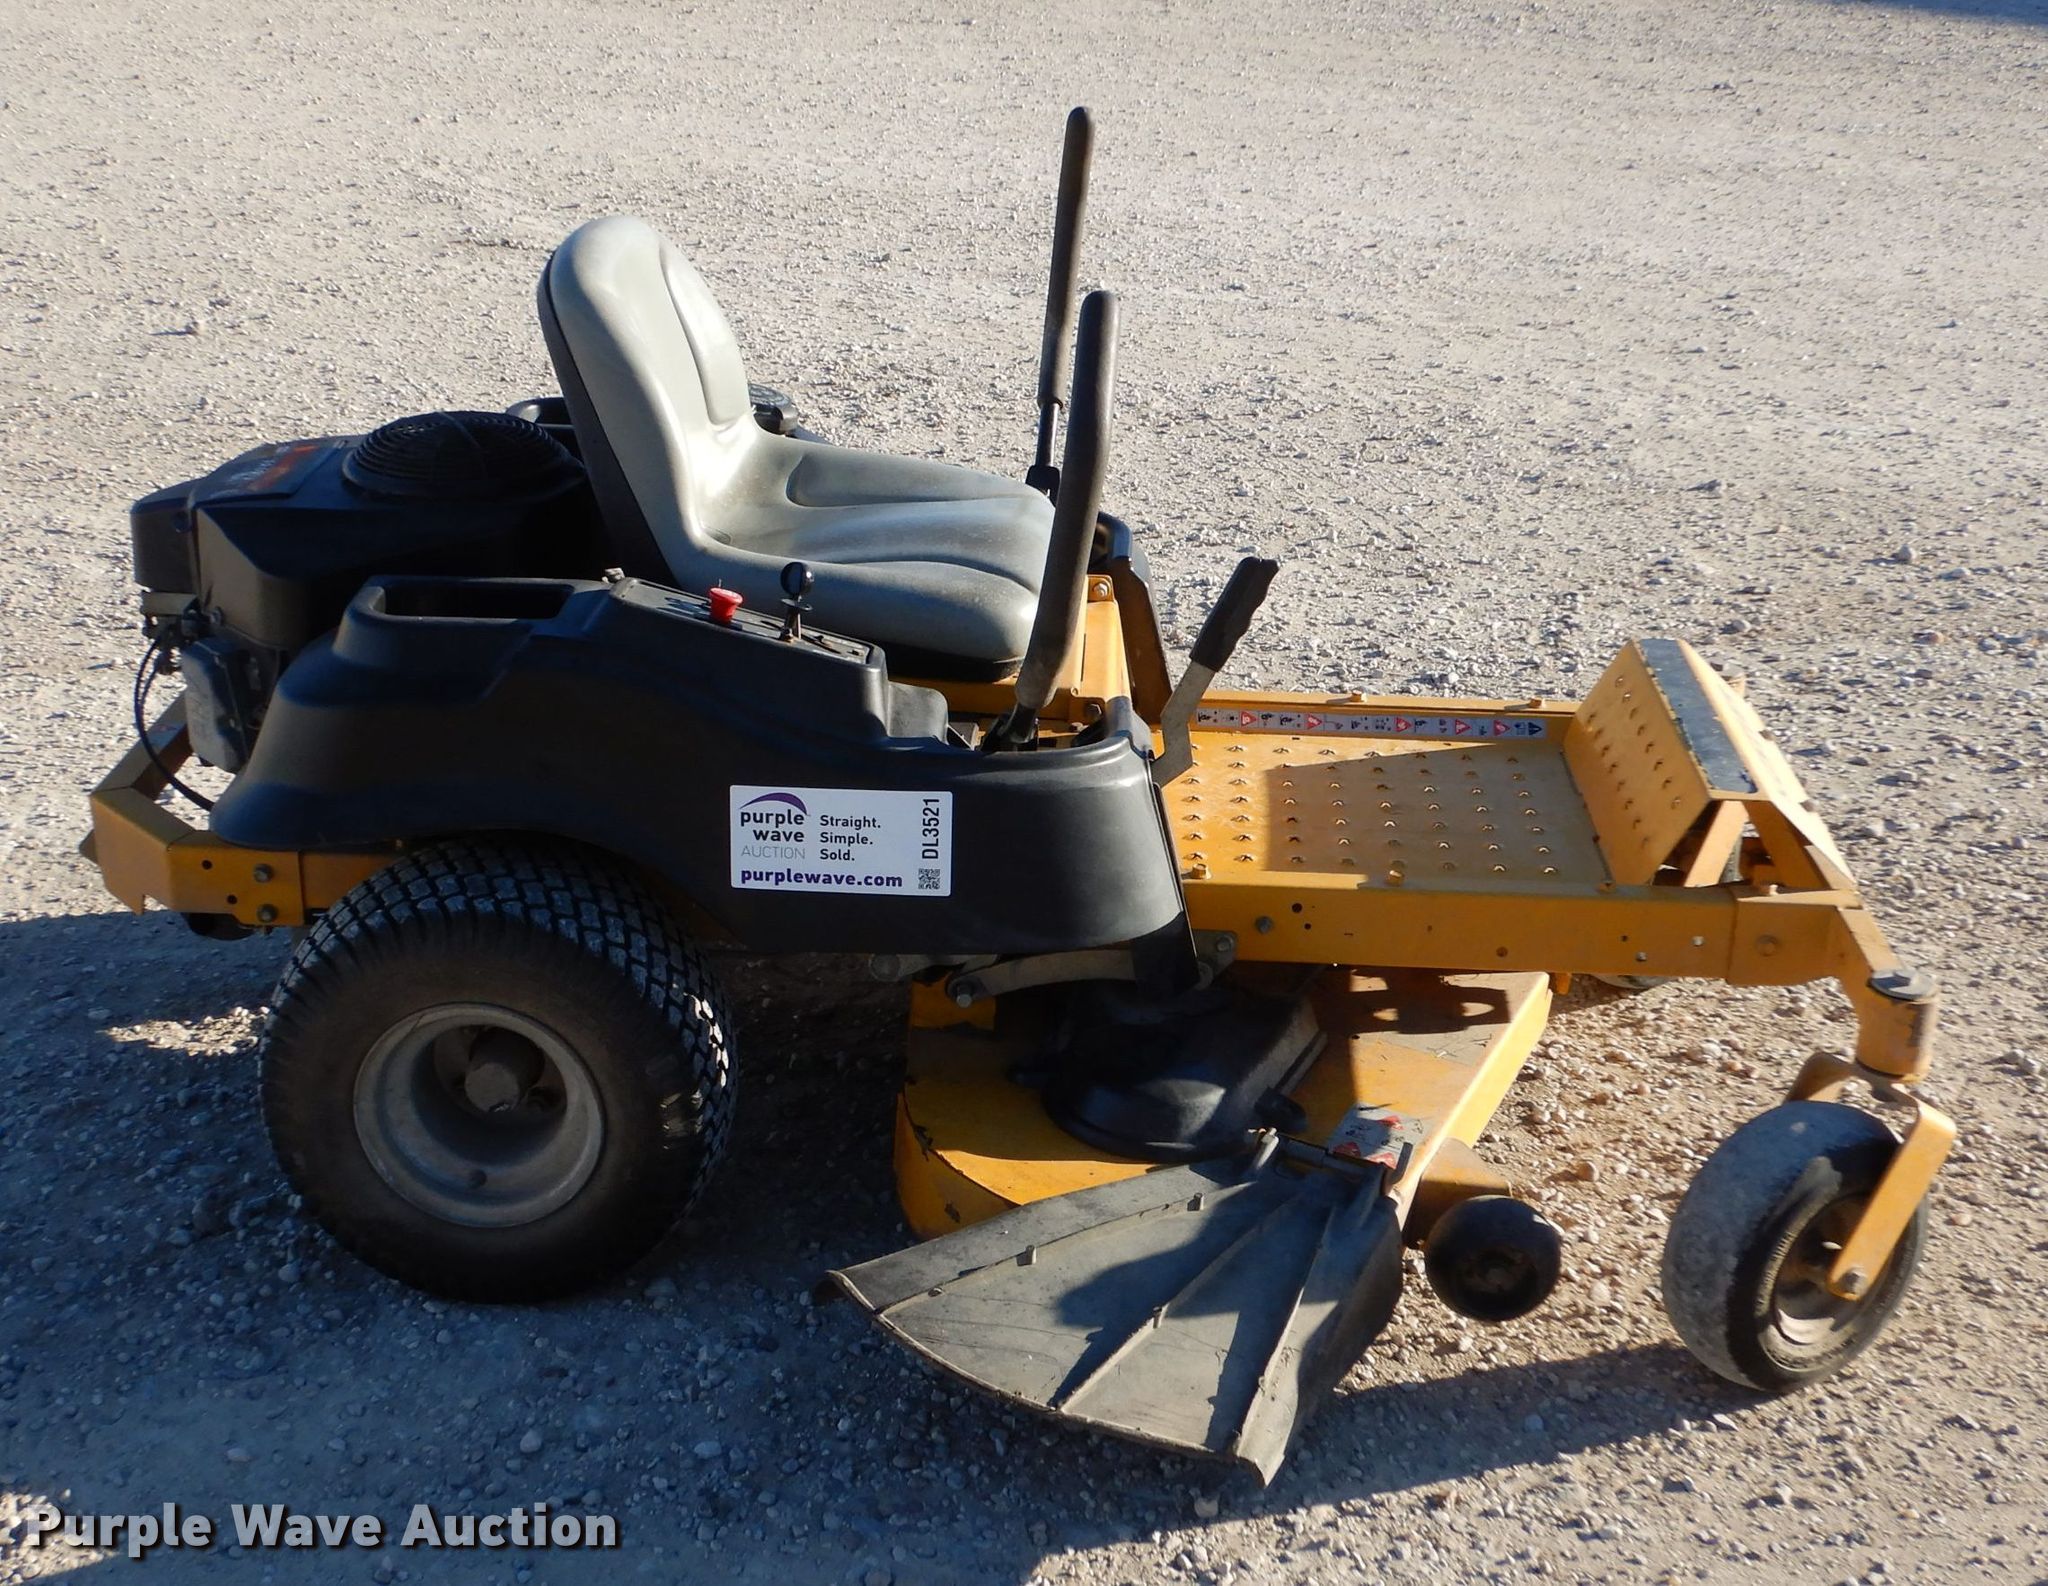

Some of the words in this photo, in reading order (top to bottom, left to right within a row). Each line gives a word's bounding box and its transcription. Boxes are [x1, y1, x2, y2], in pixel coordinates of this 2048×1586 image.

[740, 809, 805, 828] purple
[820, 815, 881, 829] Straight.
[753, 829, 805, 842] wave
[921, 798, 940, 860] DL3521
[820, 832, 874, 846] Simple.
[740, 845, 806, 859] AUCTION
[820, 849, 855, 861] Sold.
[741, 868, 903, 887] purplewave.com
